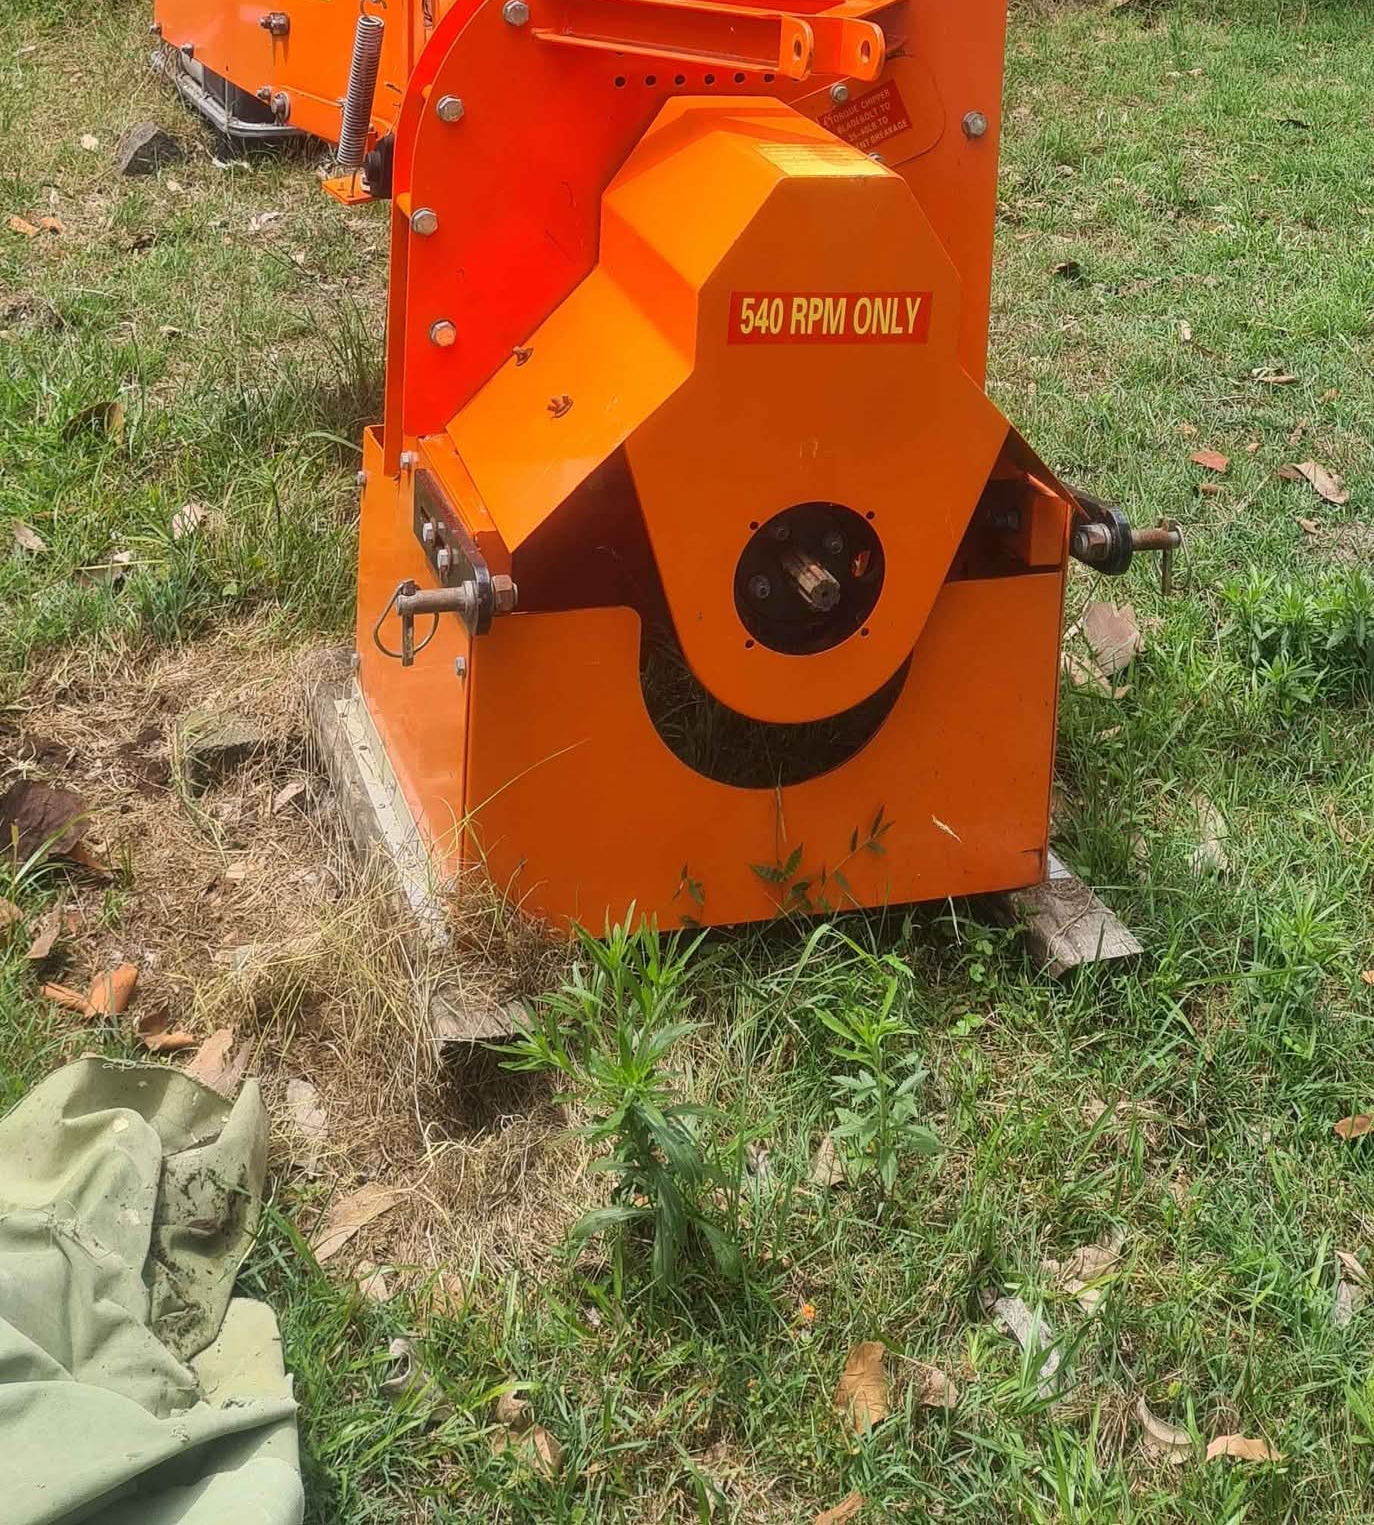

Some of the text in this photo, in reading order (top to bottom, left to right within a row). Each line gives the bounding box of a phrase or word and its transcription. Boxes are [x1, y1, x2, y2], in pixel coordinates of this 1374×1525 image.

[860, 89, 891, 109] CHIPPER
[880, 102, 891, 112] TO
[870, 118, 909, 141] BREAKAGE
[740, 297, 922, 335] 540 RPM ONLY
